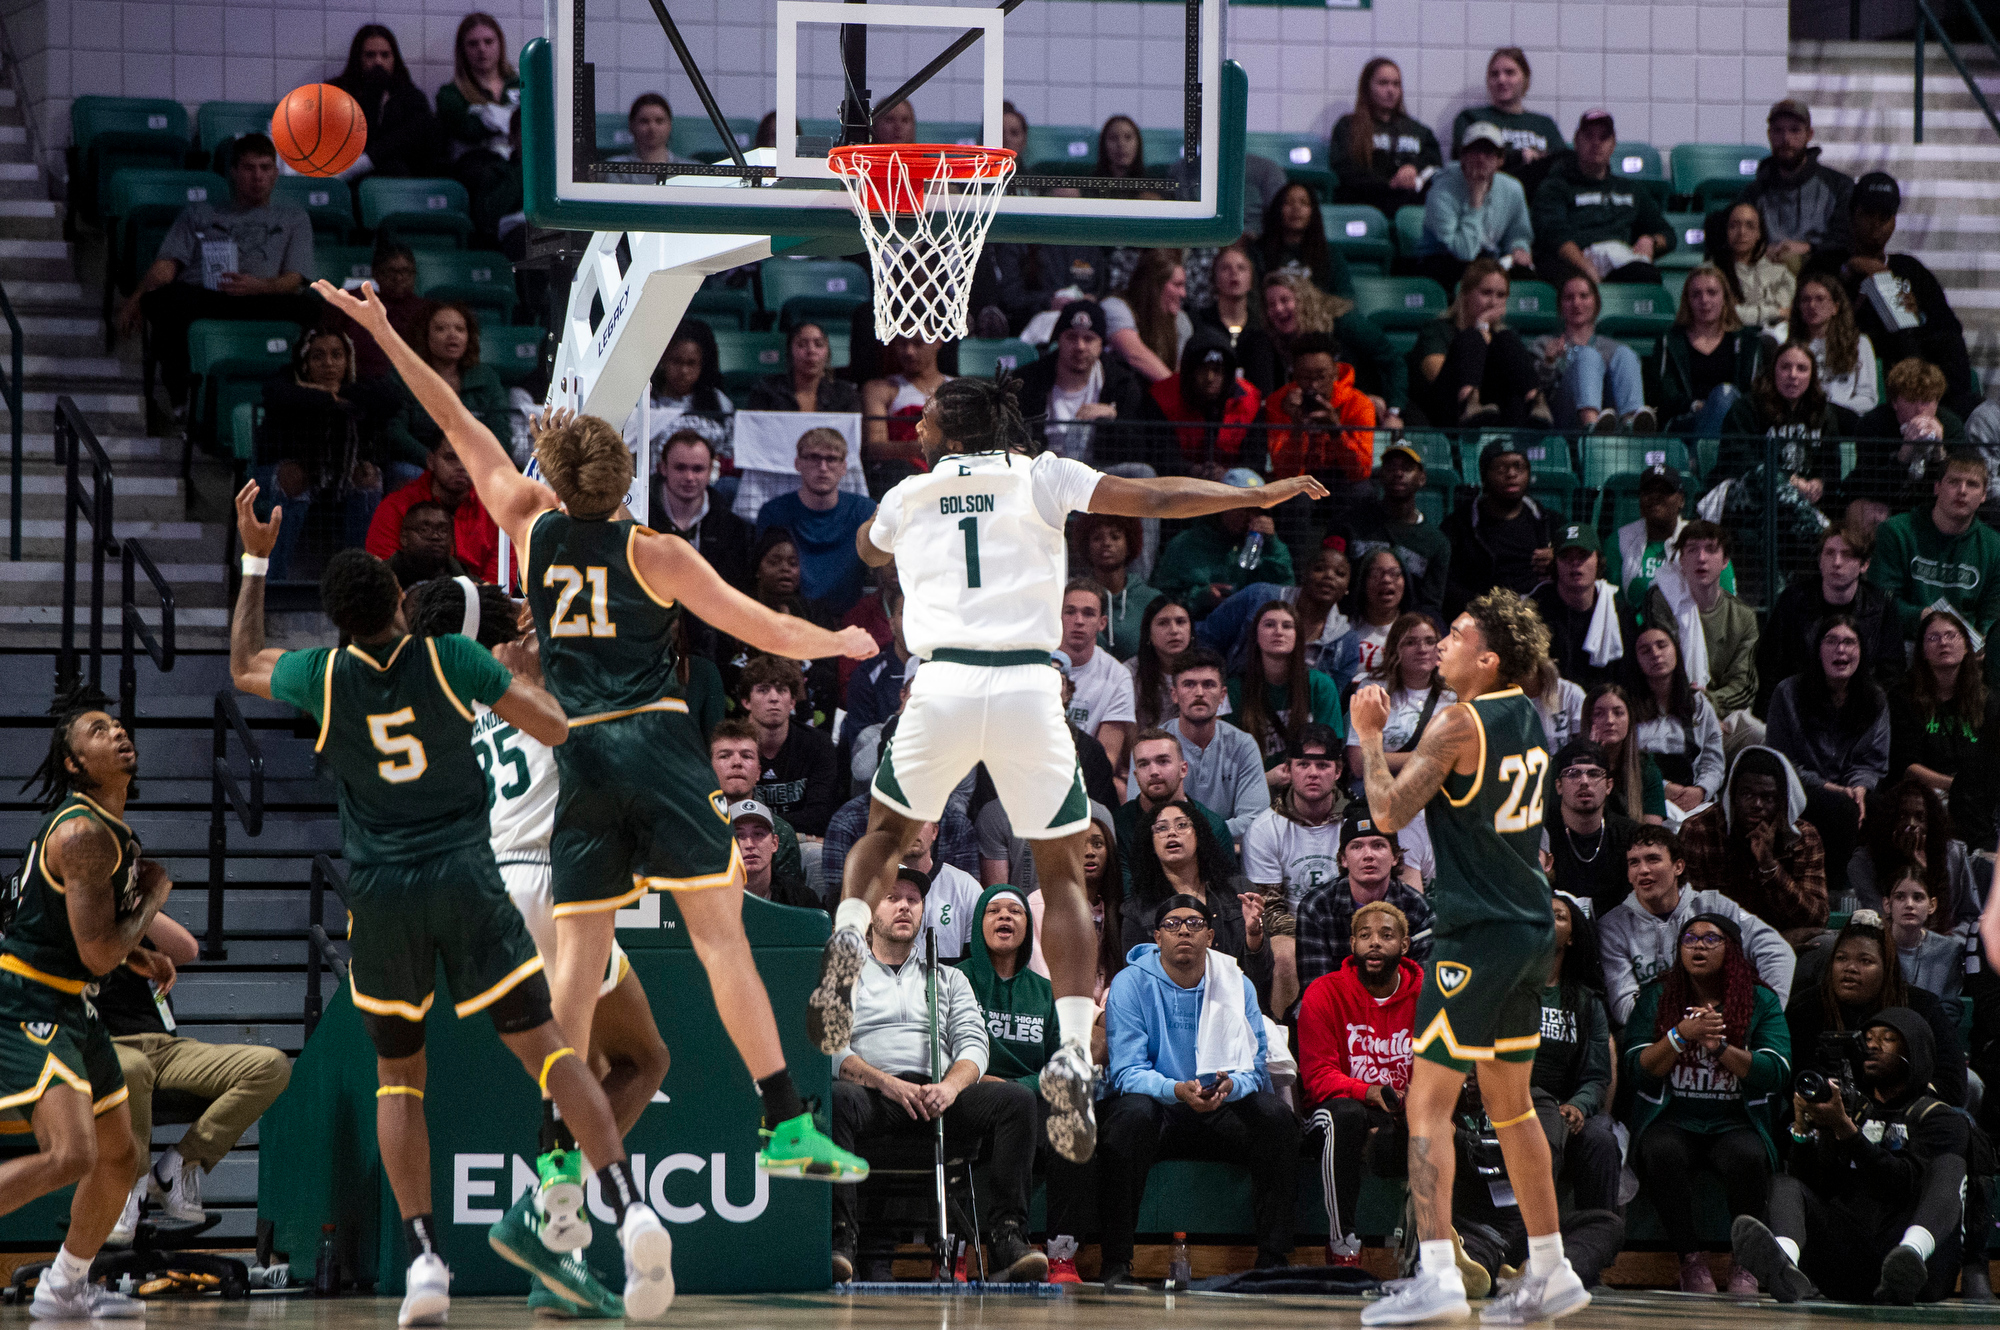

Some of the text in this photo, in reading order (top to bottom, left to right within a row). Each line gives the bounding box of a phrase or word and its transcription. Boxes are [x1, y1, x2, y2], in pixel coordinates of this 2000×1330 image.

[598, 284, 630, 358] LEGACY
[940, 494, 994, 515] GOLSON
[958, 516, 982, 589] 1
[543, 564, 617, 639] 21
[366, 706, 428, 784] 5
[1494, 745, 1549, 833] 22
[1310, 870, 1323, 887] E
[662, 920, 676, 929] TM
